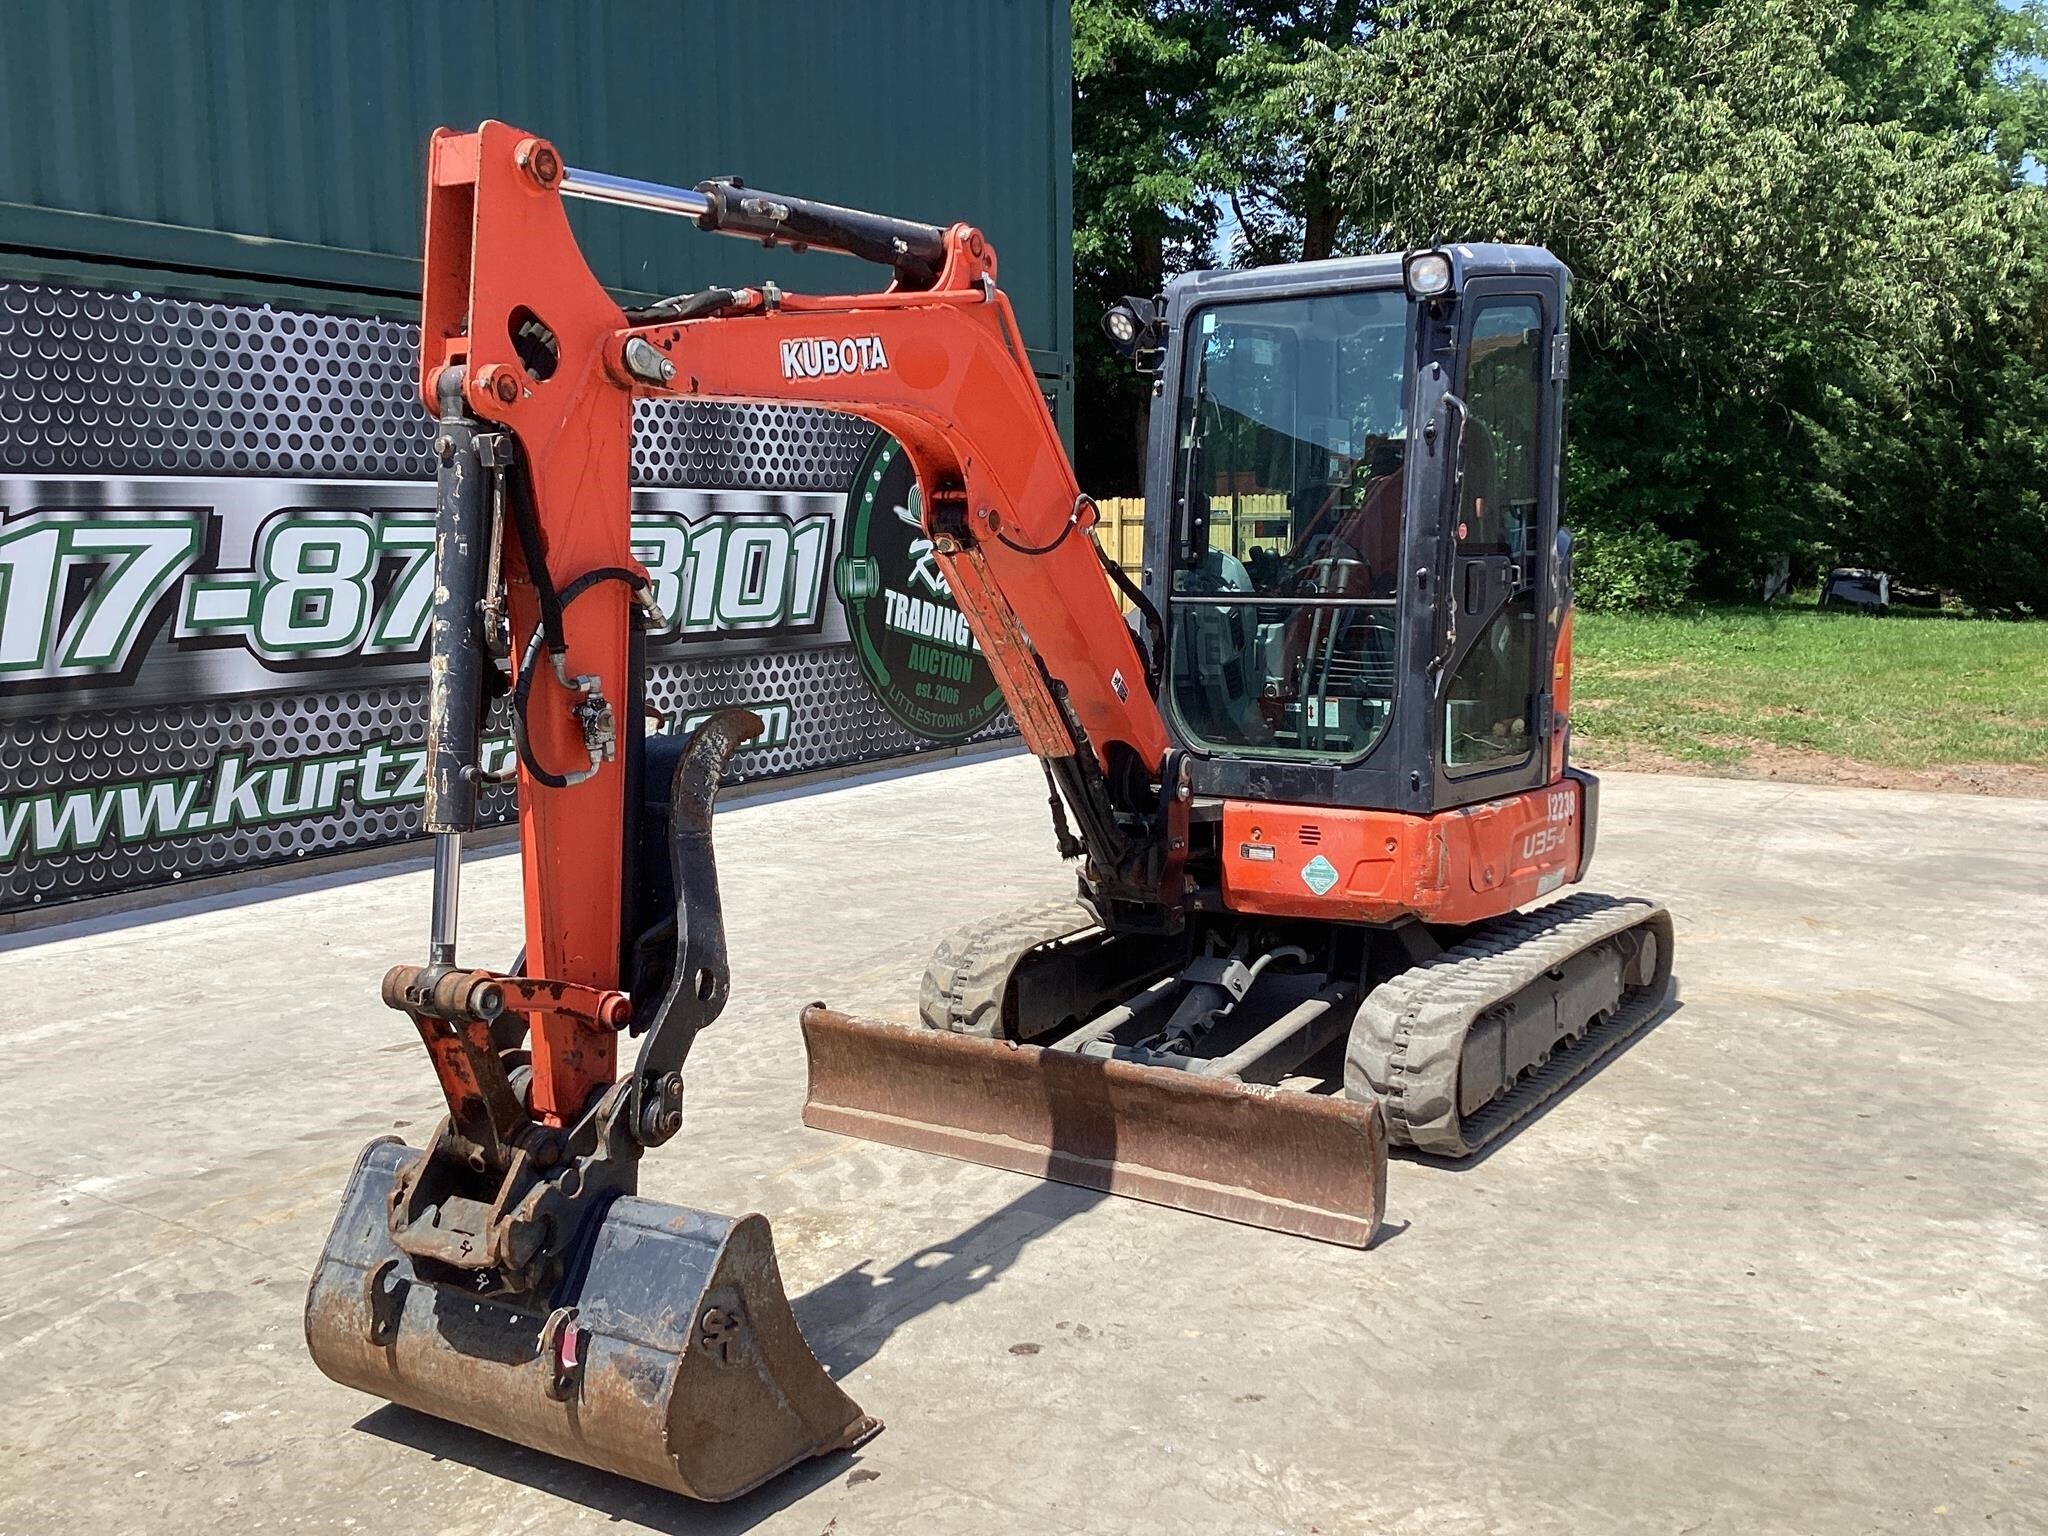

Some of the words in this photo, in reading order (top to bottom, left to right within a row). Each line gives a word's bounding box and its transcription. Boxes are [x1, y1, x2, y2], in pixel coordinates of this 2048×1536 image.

[781, 337, 888, 378] KUBOTA
[885, 588, 970, 647] TRADING
[908, 643, 973, 683] AUCTION
[889, 684, 967, 728] LITTLESTOWN,
[969, 705, 983, 720] PA
[935, 684, 960, 705] 2006
